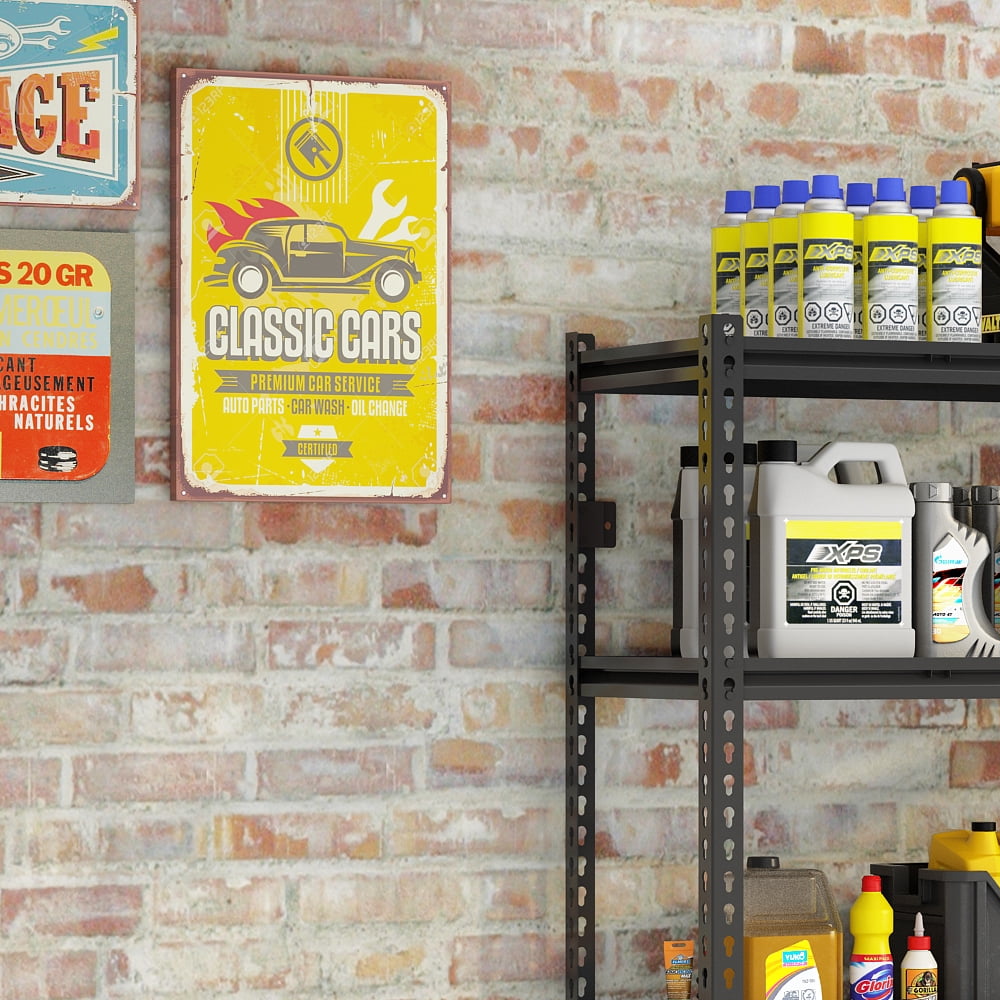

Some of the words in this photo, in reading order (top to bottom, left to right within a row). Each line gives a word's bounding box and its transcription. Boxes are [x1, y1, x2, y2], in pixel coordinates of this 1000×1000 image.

[17, 261, 51, 285] 20
[56, 263, 93, 287] GR
[21, 331, 97, 349] CENDRES
[206, 306, 334, 361] CLASSIC
[338, 309, 421, 364] CARS
[0, 375, 95, 392] GEUSEMENT
[250, 373, 306, 391] PREMIUM
[308, 375, 331, 392] CAR
[334, 376, 381, 393] SERVICE
[223, 397, 249, 414] AUTO
[251, 398, 285, 415] PARTS
[291, 399, 314, 415] CAR
[314, 399, 345, 415] WASH
[351, 400, 367, 416] OIL
[368, 400, 408, 417] CHANGE
[14, 413, 94, 431] NATURELS
[297, 442, 338, 456] CERTIFIED
[815, 541, 883, 565] XPS
